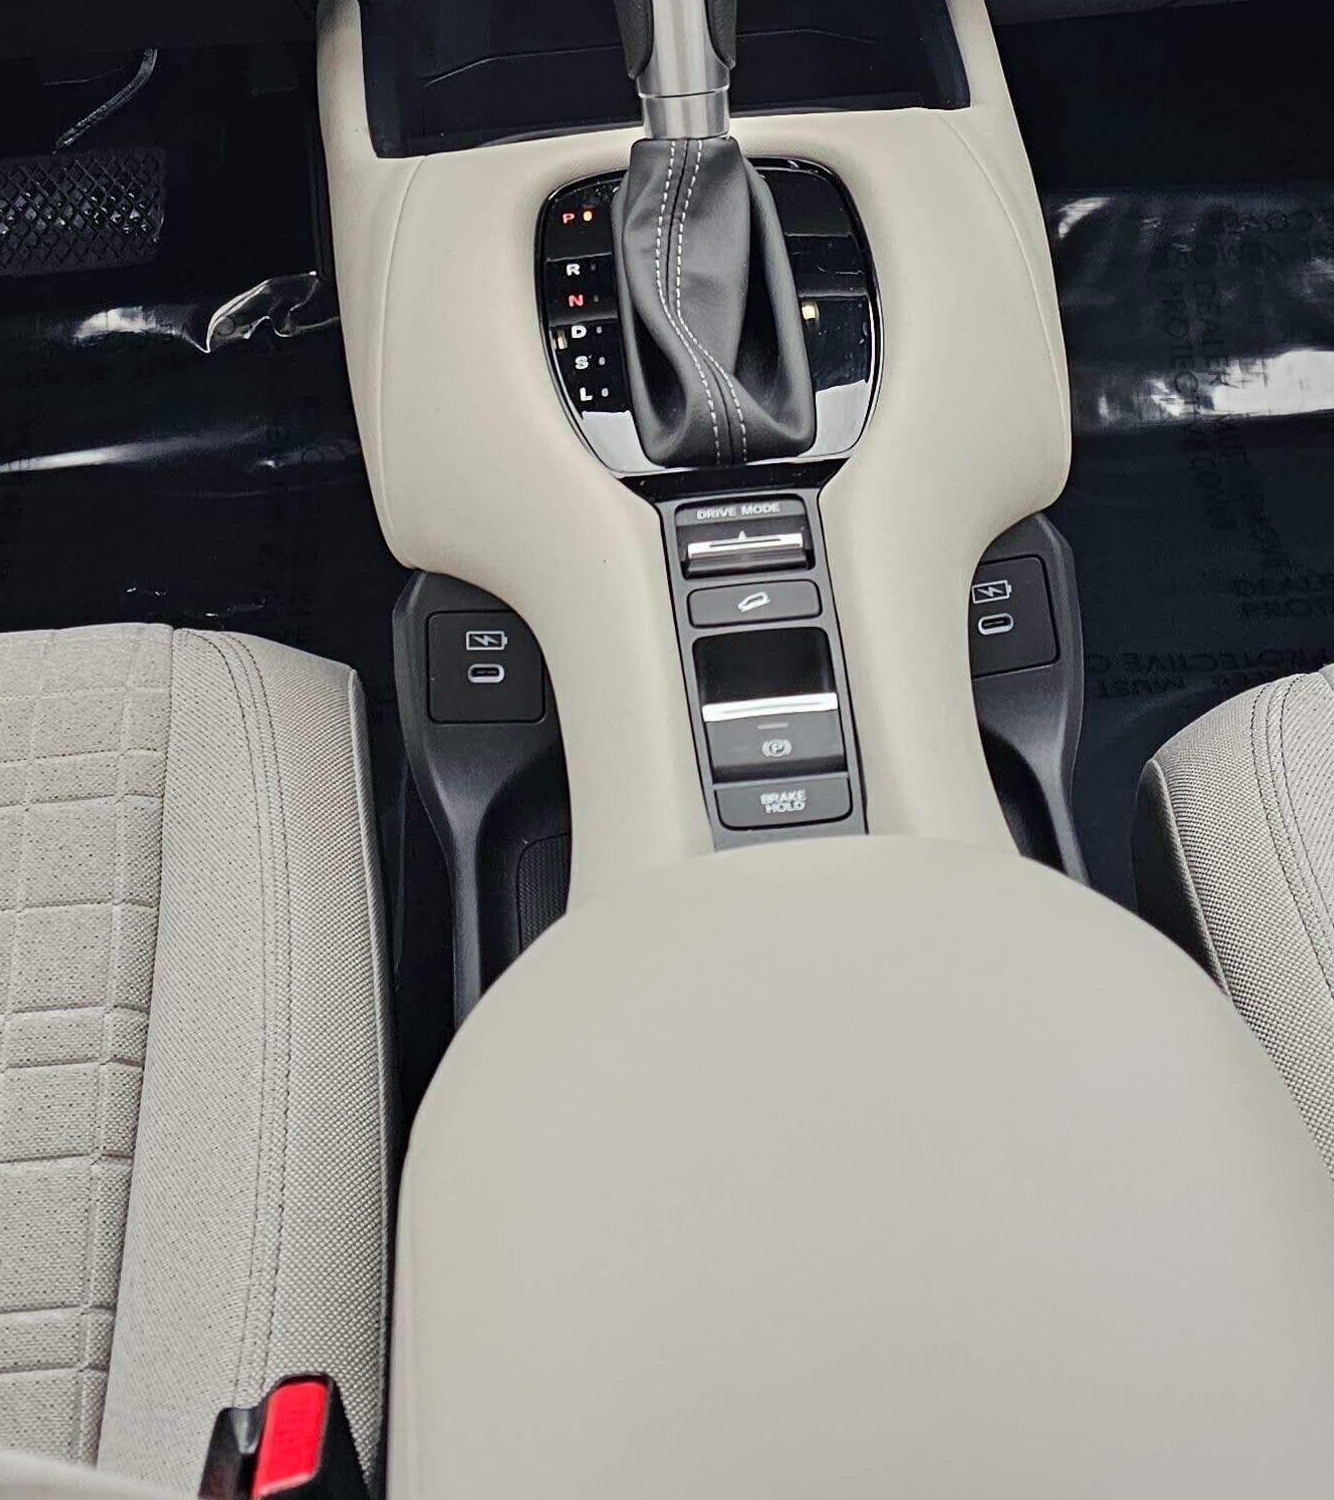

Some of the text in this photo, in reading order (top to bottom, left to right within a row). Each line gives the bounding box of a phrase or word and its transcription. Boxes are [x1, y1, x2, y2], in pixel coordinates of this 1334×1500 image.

[562, 212, 575, 225] P
[566, 262, 581, 277] R
[568, 294, 584, 307] N
[571, 325, 587, 339] D
[574, 355, 590, 370] S
[579, 387, 594, 402] L
[696, 502, 781, 521] DRIVE MODE
[760, 789, 807, 805] BRAKE
[765, 799, 806, 814] HOLD
